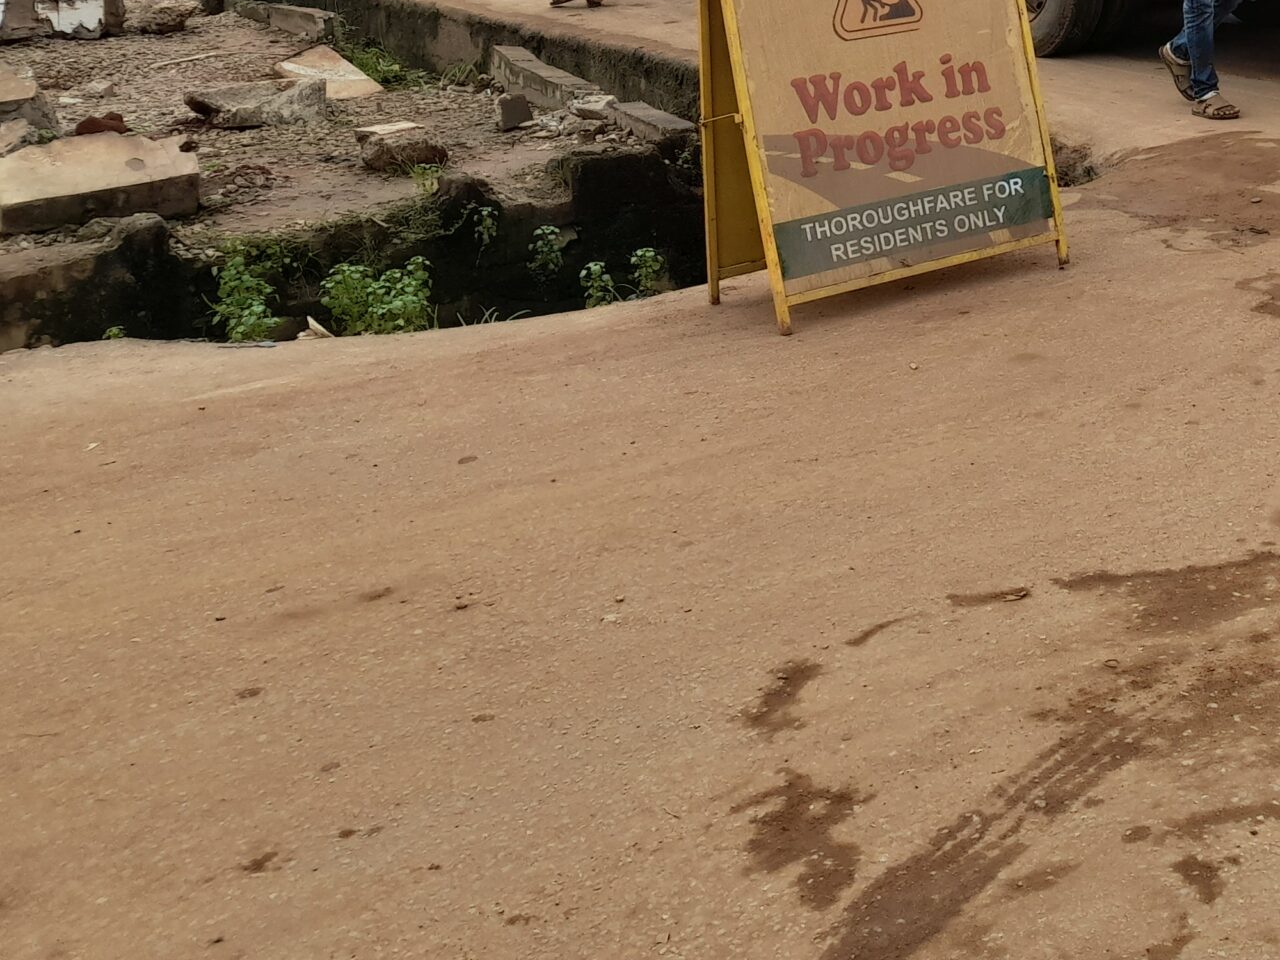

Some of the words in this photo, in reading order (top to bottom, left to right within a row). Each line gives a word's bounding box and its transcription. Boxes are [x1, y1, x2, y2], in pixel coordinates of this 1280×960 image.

[791, 60, 933, 124] Work
[939, 53, 991, 98] in
[792, 106, 1006, 178] Progress
[801, 187, 978, 242] THOROUGHFARE
[983, 177, 1024, 202] FOR
[830, 219, 949, 262] RESIDENTS
[954, 205, 1007, 233] ONLY
